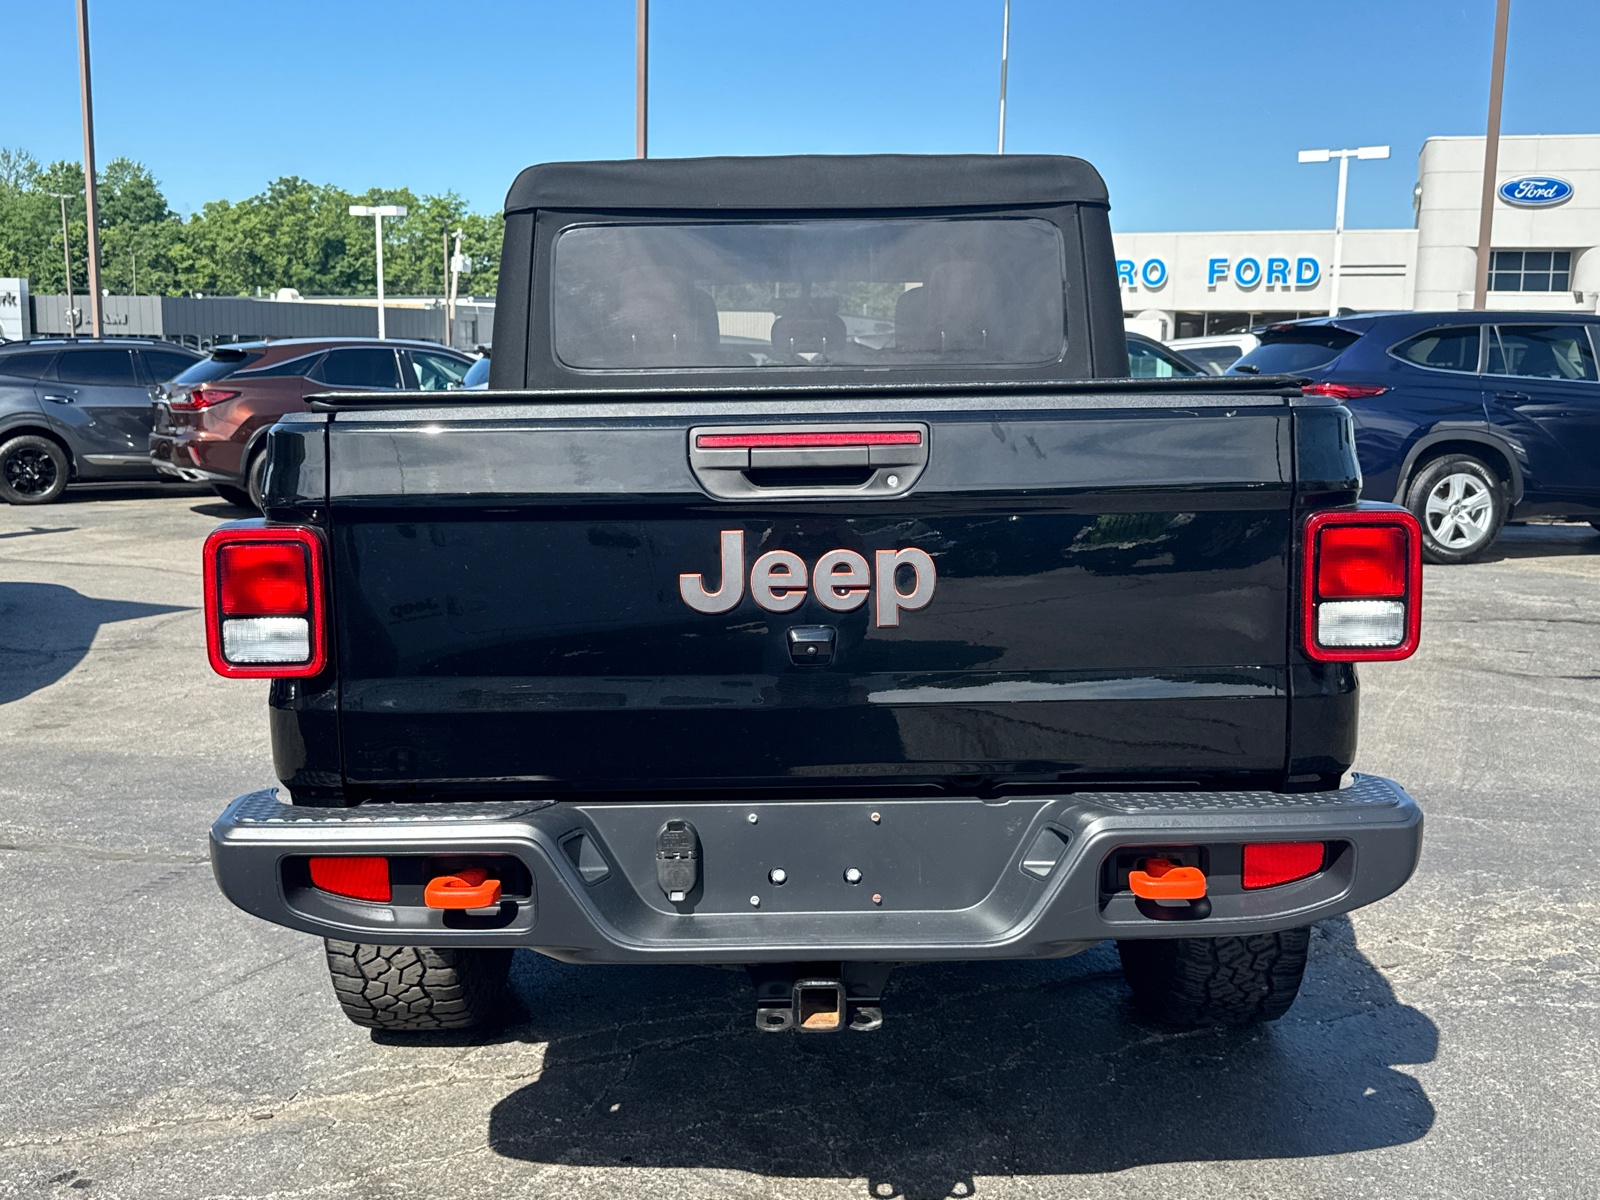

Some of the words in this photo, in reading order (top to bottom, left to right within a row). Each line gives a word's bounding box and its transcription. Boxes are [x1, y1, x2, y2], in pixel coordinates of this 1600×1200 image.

[1514, 180, 1559, 198] Ford
[1116, 258, 1168, 287] RO
[1208, 257, 1321, 287] FORD
[679, 530, 937, 628] Jeep
